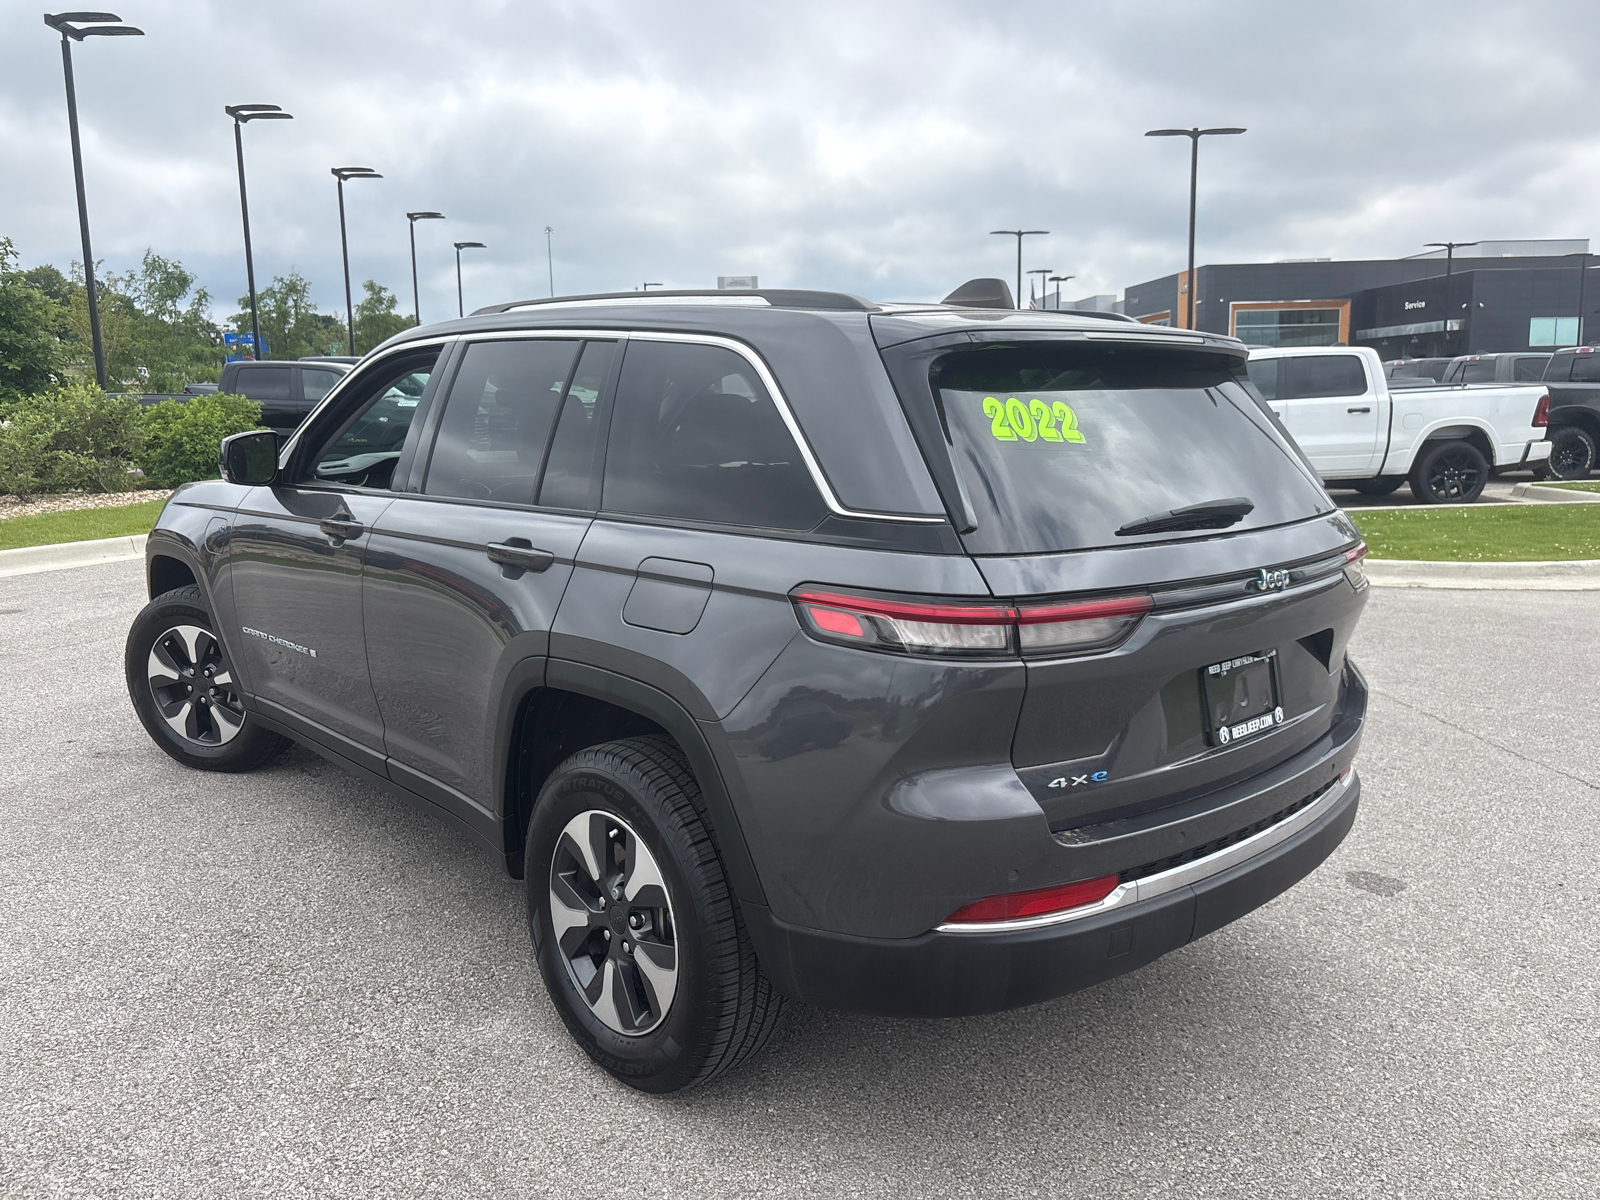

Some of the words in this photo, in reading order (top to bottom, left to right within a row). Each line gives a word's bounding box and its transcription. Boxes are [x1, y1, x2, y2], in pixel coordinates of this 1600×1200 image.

[1404, 300, 1425, 310] Service
[982, 396, 1087, 444] 2022
[1257, 568, 1290, 590] Jeep
[242, 626, 268, 640] GRAND
[268, 635, 309, 655] CHEROKEE
[1208, 664, 1220, 675] REED
[1221, 661, 1231, 671] JEEP
[1231, 715, 1273, 739] REEDJEEP.COM
[563, 777, 625, 802] STRATUS
